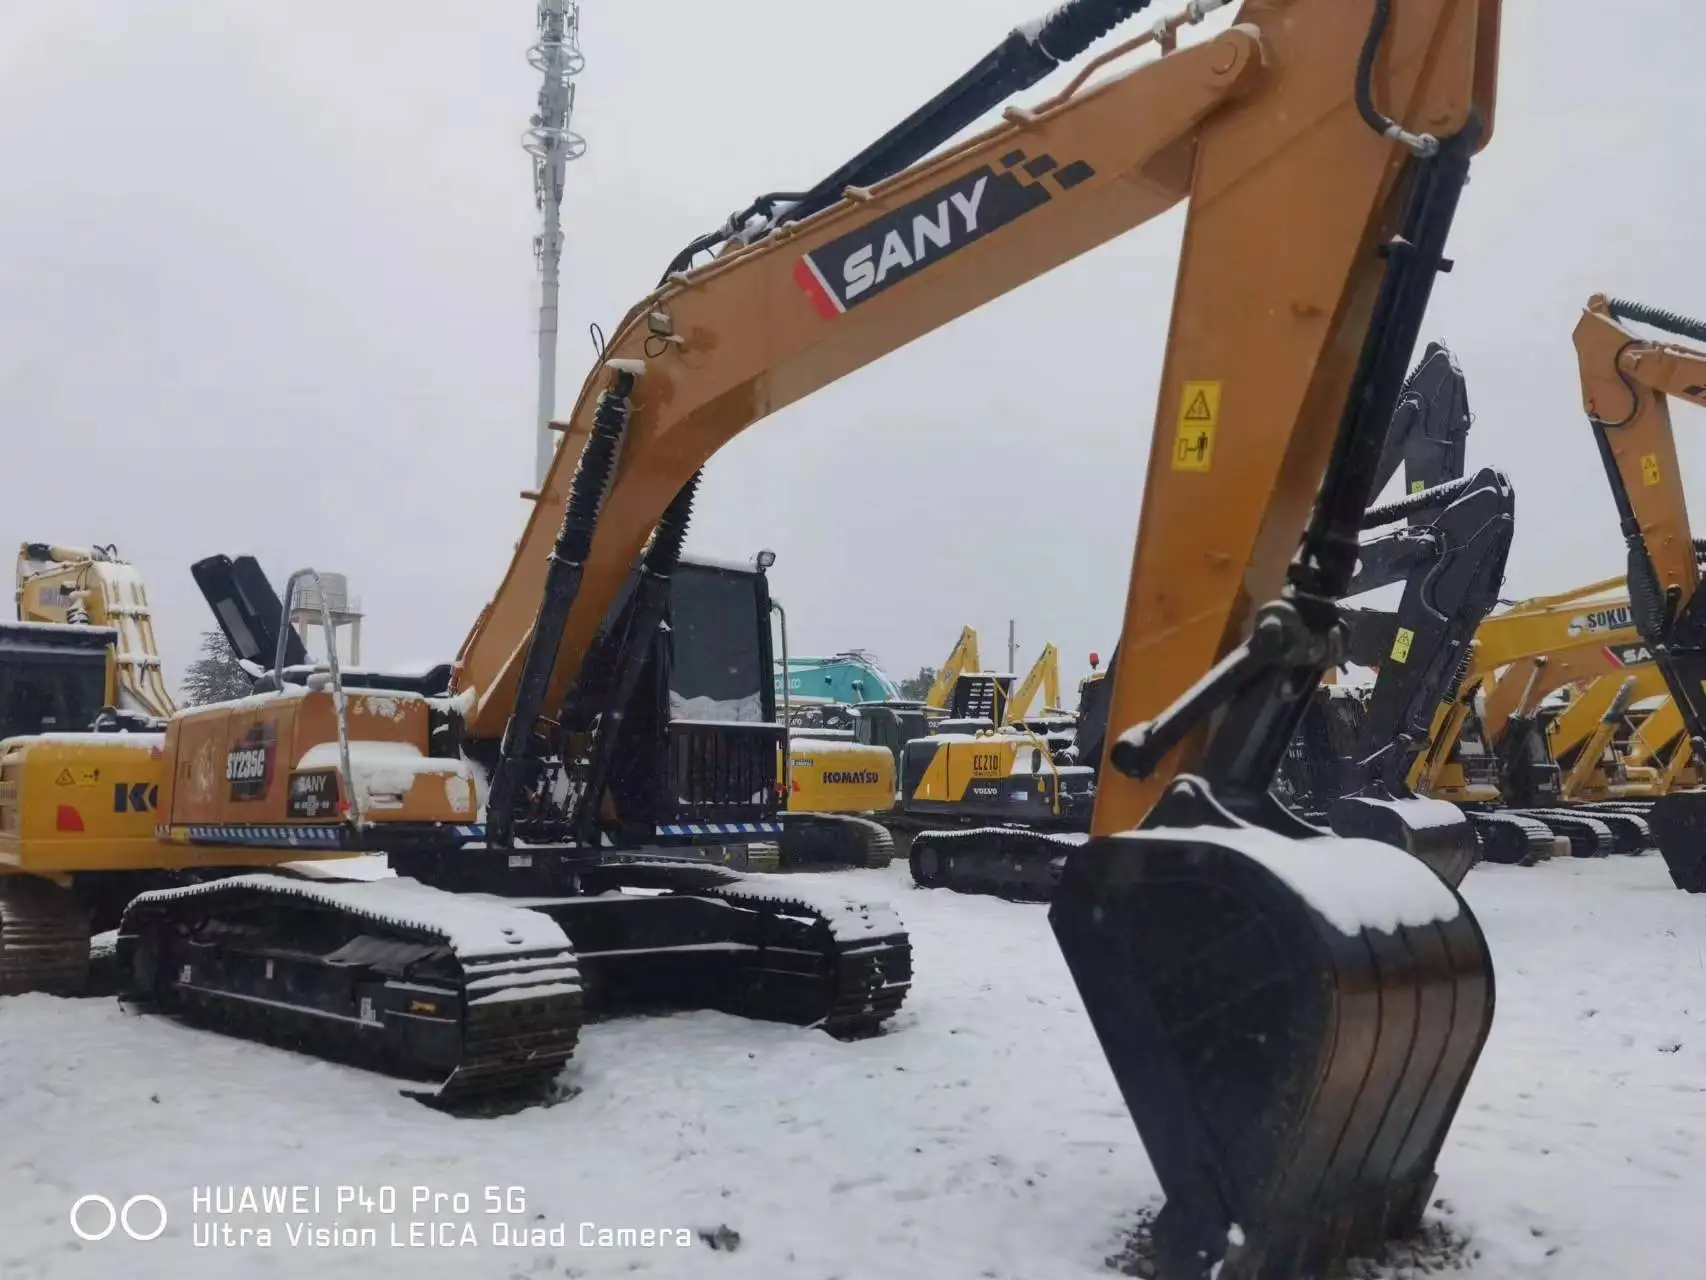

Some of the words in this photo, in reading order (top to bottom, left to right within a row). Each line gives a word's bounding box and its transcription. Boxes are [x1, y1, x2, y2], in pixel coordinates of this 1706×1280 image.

[843, 175, 988, 300] SANY
[1623, 648, 1653, 664] SA
[823, 769, 879, 784] KOMATSU
